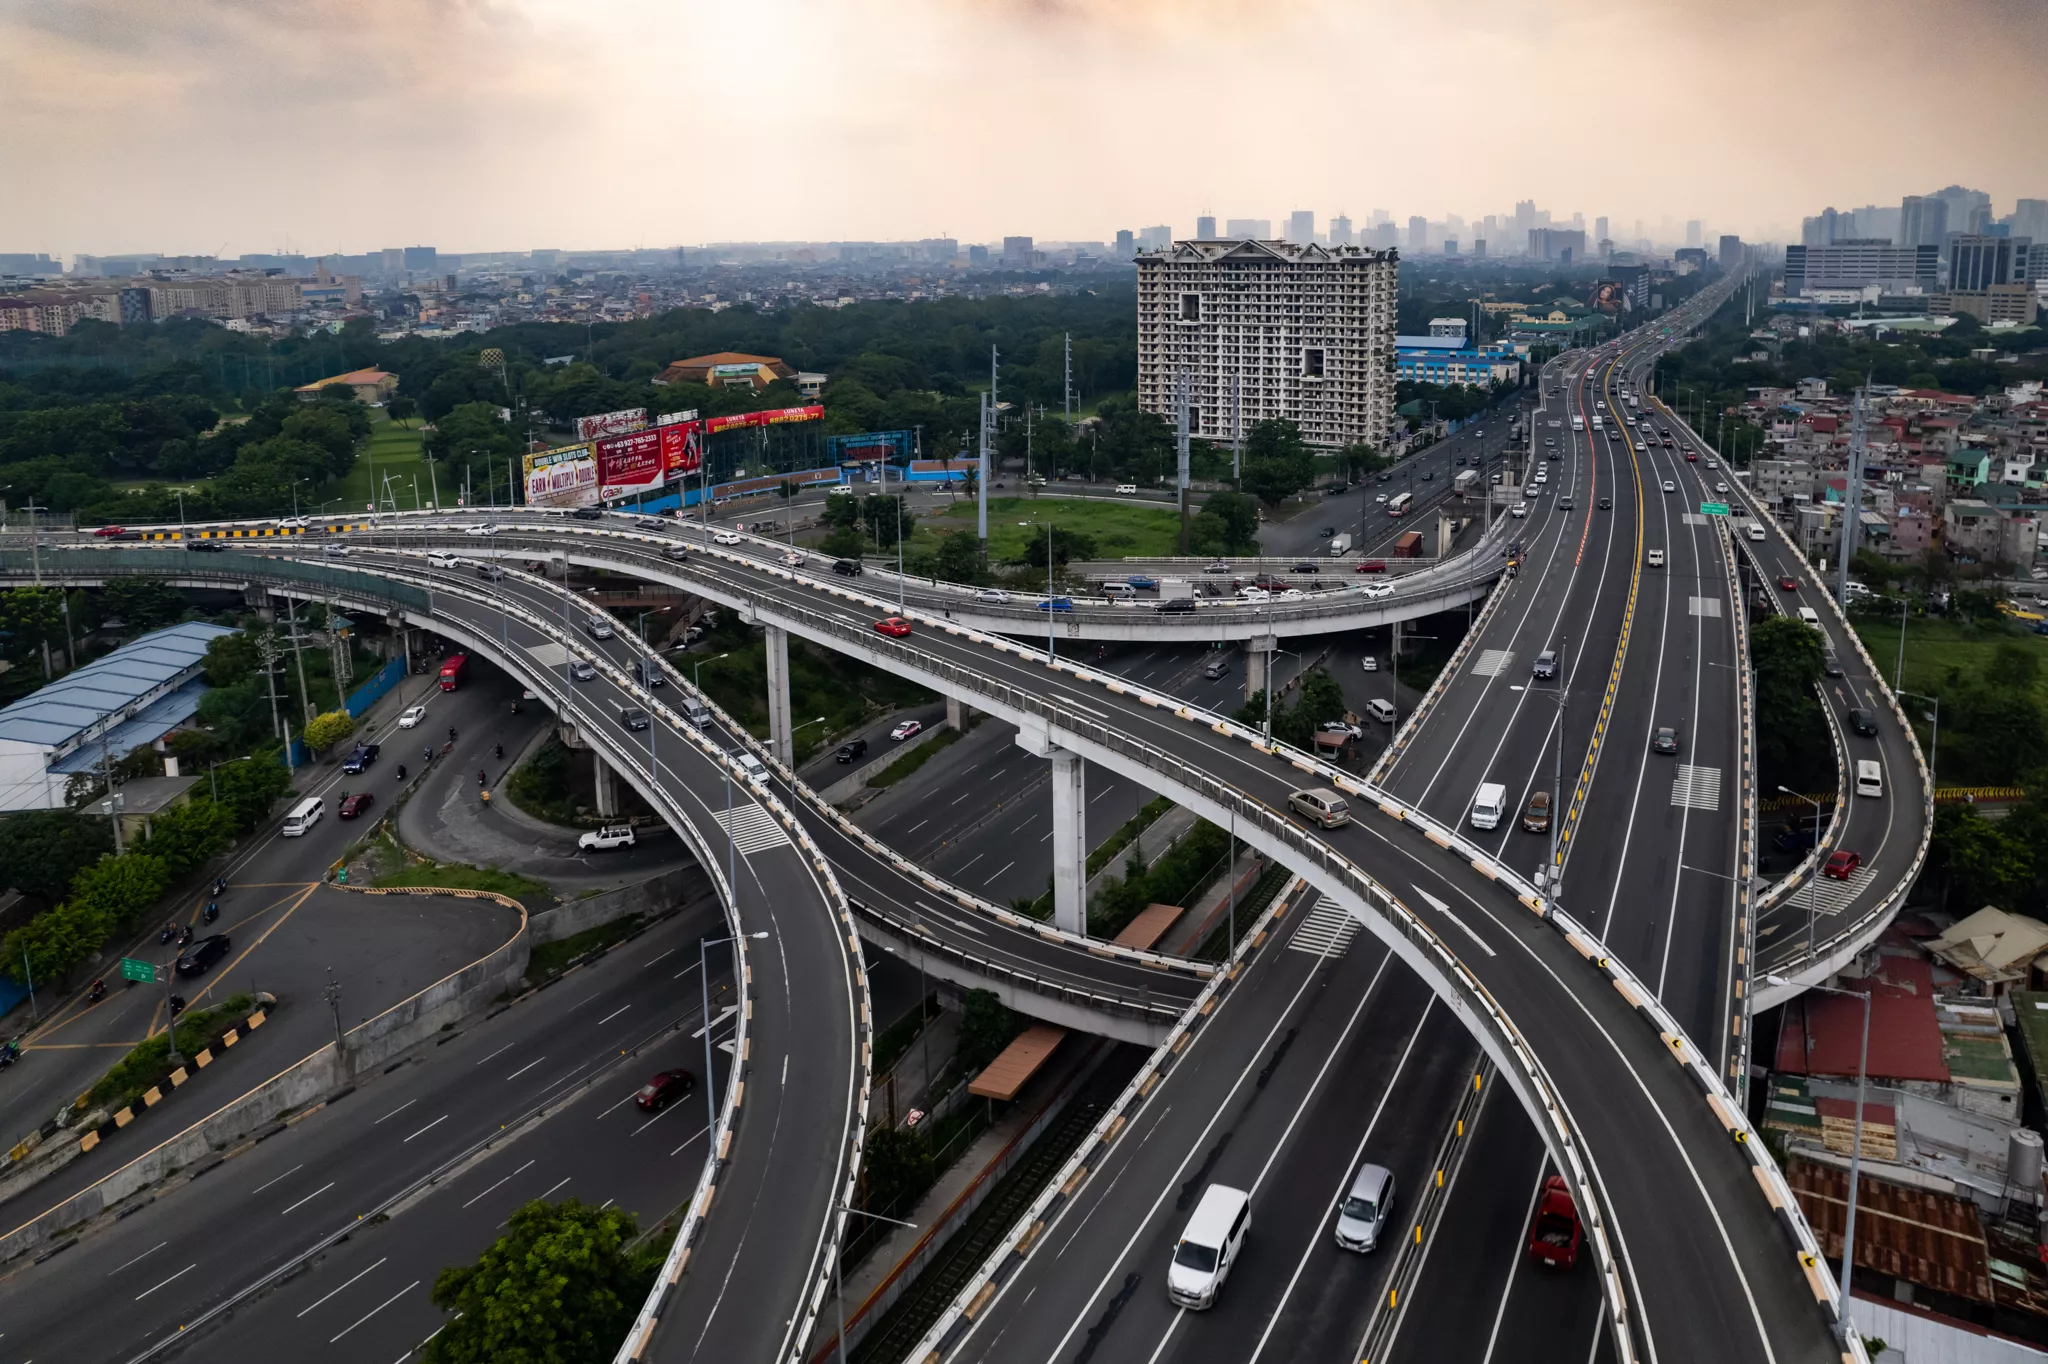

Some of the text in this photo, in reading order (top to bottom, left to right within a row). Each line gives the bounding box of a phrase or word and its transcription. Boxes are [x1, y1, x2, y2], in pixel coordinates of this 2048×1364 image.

[726, 414, 745, 422] LUNETA
[624, 434, 657, 447] 927-765-2333
[534, 456, 552, 466] DOUBLE
[552, 454, 562, 463] WIN
[563, 451, 576, 460] SLOTS
[551, 471, 574, 489] MULTIPLY
[578, 466, 594, 483] DOUBLE
